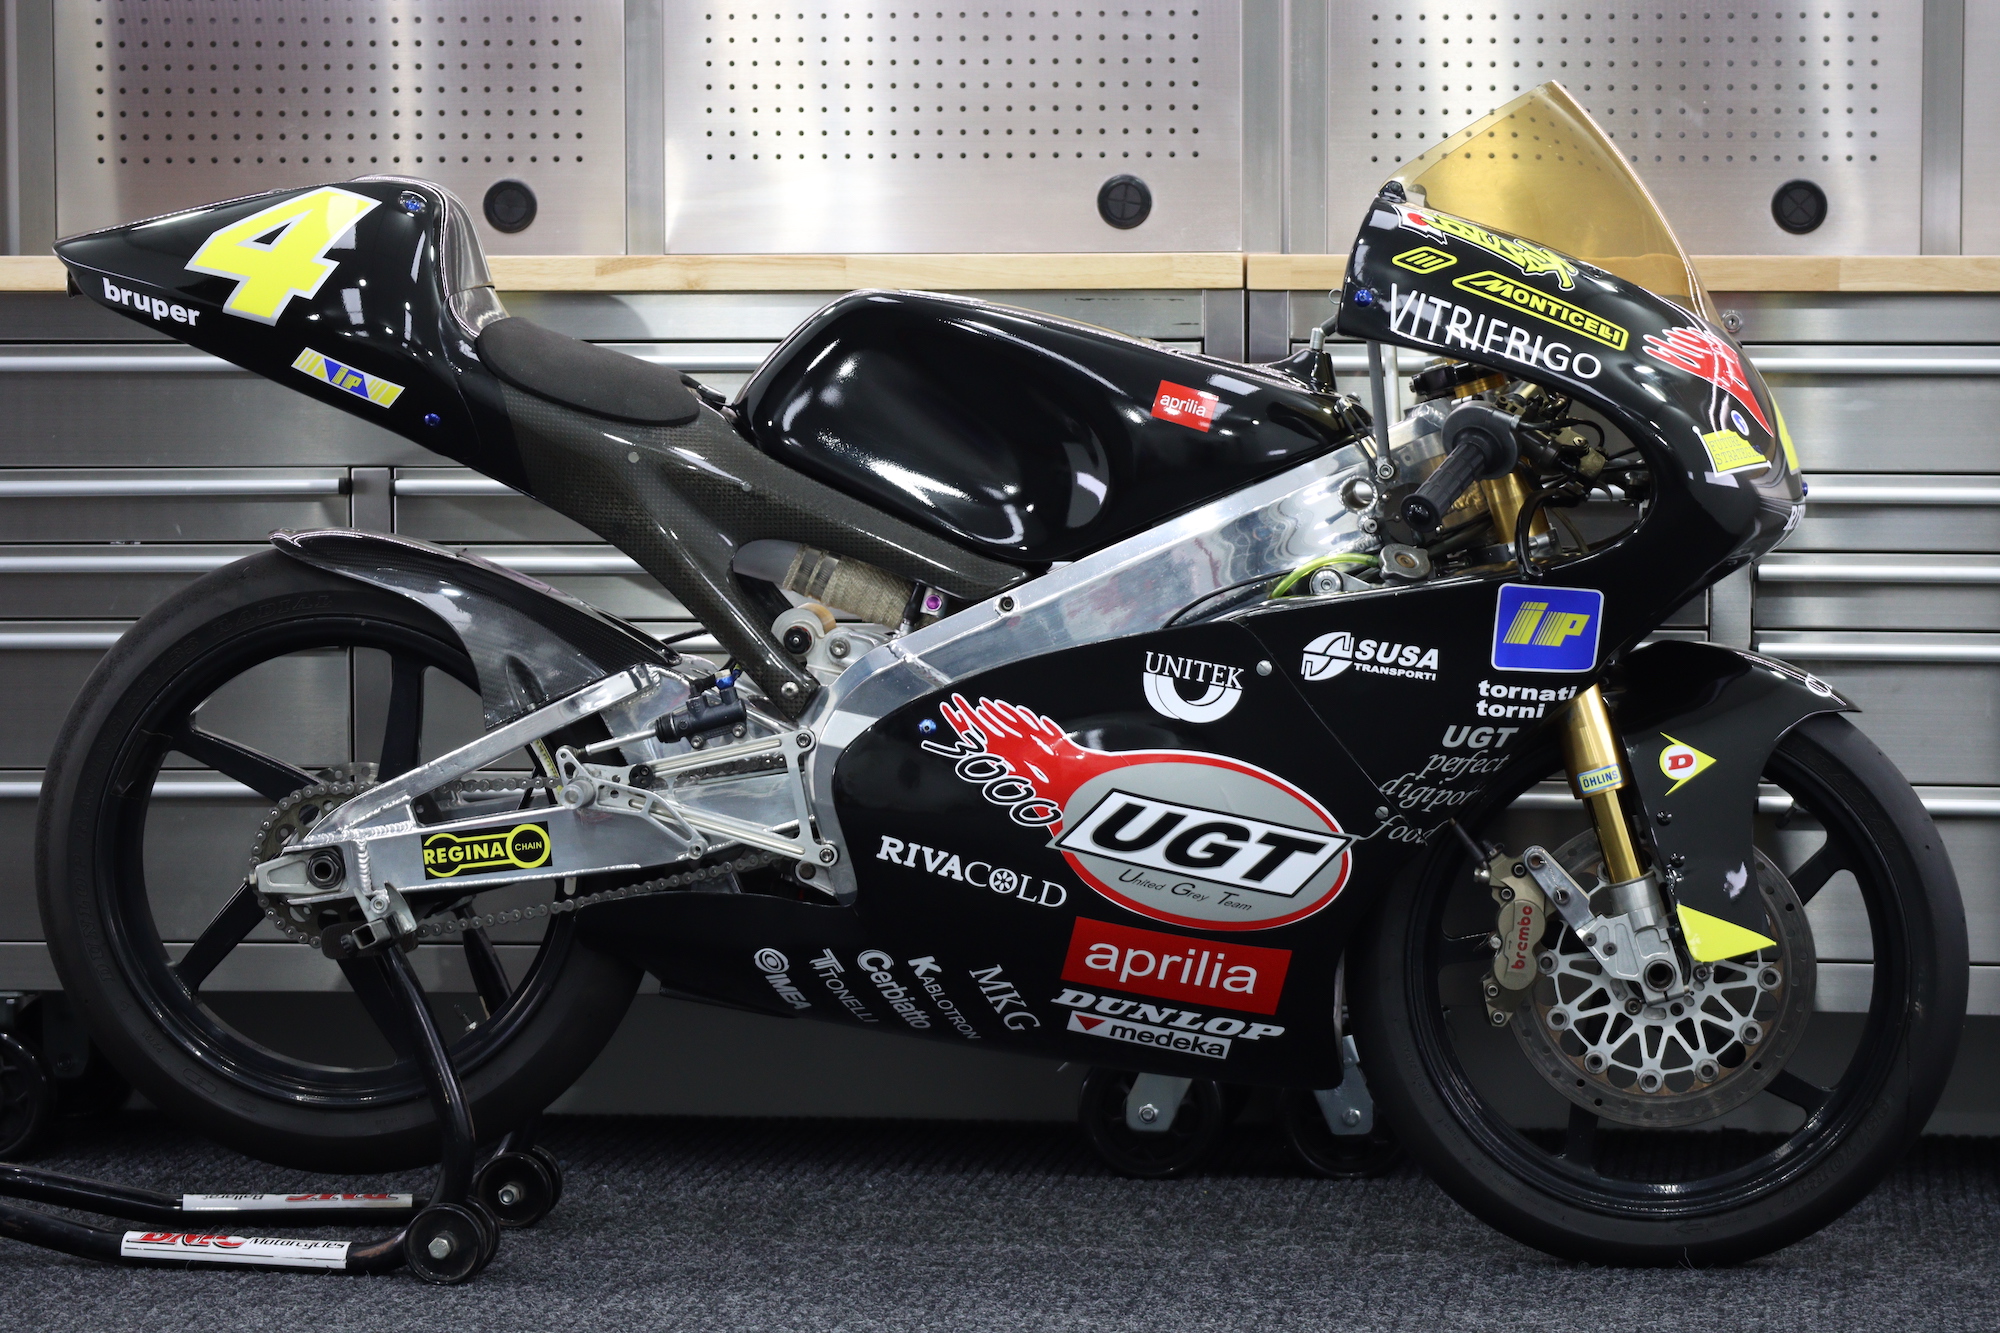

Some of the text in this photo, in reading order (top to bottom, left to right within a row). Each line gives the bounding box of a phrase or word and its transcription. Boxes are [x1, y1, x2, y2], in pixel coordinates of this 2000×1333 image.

[184, 186, 382, 326] 4
[102, 277, 200, 326] bruper
[1469, 273, 1621, 344] MONTICELLI
[1390, 283, 1602, 379] VITRIFRIGO
[1160, 394, 1206, 417] aprilia
[1144, 651, 1245, 689] UNITEK
[1353, 662, 1437, 681] TRANSPORTI
[1355, 639, 1439, 671] SUSA
[1476, 699, 1546, 719] torni
[1478, 680, 1578, 702] tornati
[1441, 724, 1520, 749] UGT
[921, 730, 1064, 827] 3000
[1414, 749, 1511, 782] perfect
[1583, 770, 1619, 788] ÖHLINS
[1668, 754, 1693, 770] D
[423, 841, 542, 865] REGINA CHAIN
[1091, 801, 1330, 884] UGT
[876, 835, 1067, 908] RIVACOLD
[1118, 868, 1253, 911] United Grey Team
[1511, 905, 1532, 970] brembo
[857, 950, 931, 1029] Cerbiatto
[1084, 942, 1258, 994] aprilia
[908, 956, 981, 1039] KABLOTRON
[969, 964, 1041, 1030] MKG
[1050, 988, 1286, 1040] DUNLOP
[1109, 1024, 1226, 1057] medeka
